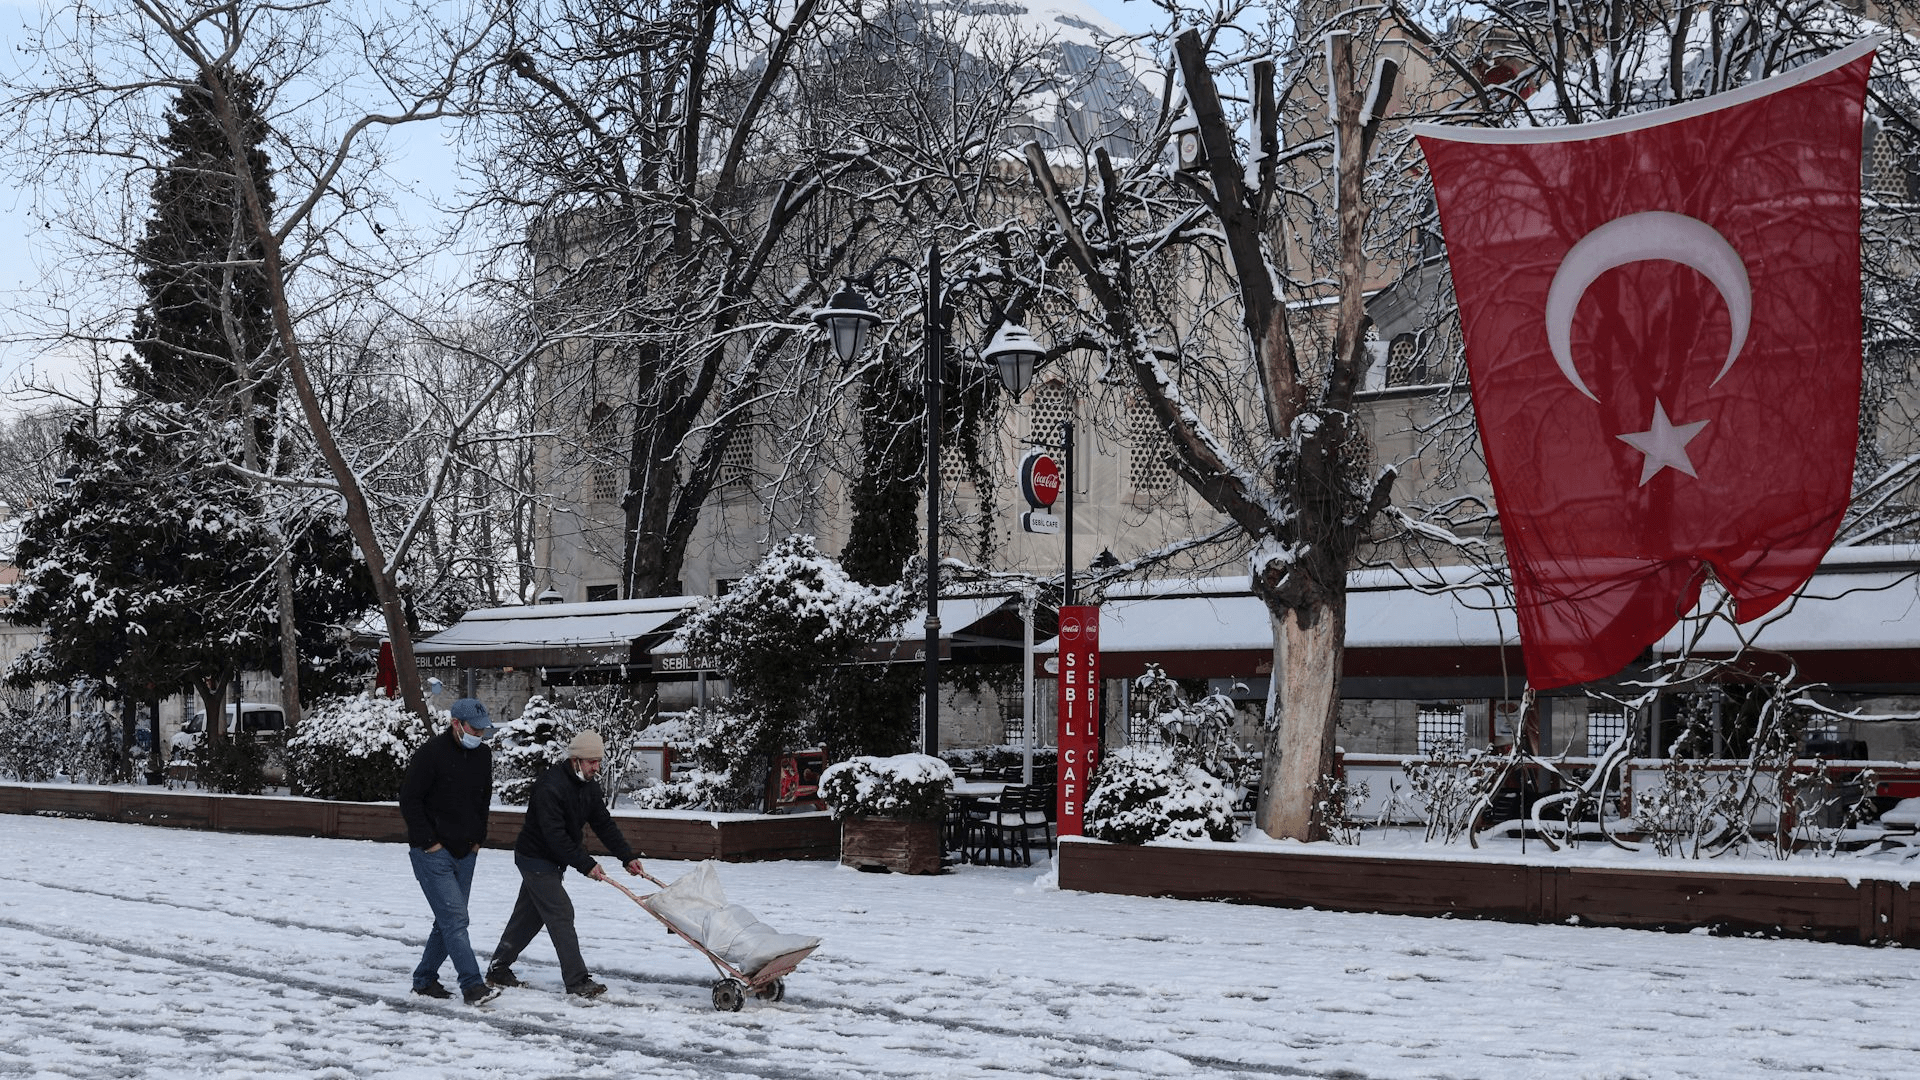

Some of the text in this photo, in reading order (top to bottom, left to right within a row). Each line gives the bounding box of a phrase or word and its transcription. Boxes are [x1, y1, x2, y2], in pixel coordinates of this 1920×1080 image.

[414, 655, 457, 668] EBIL CAFE
[1063, 749, 1076, 815] CAFE
